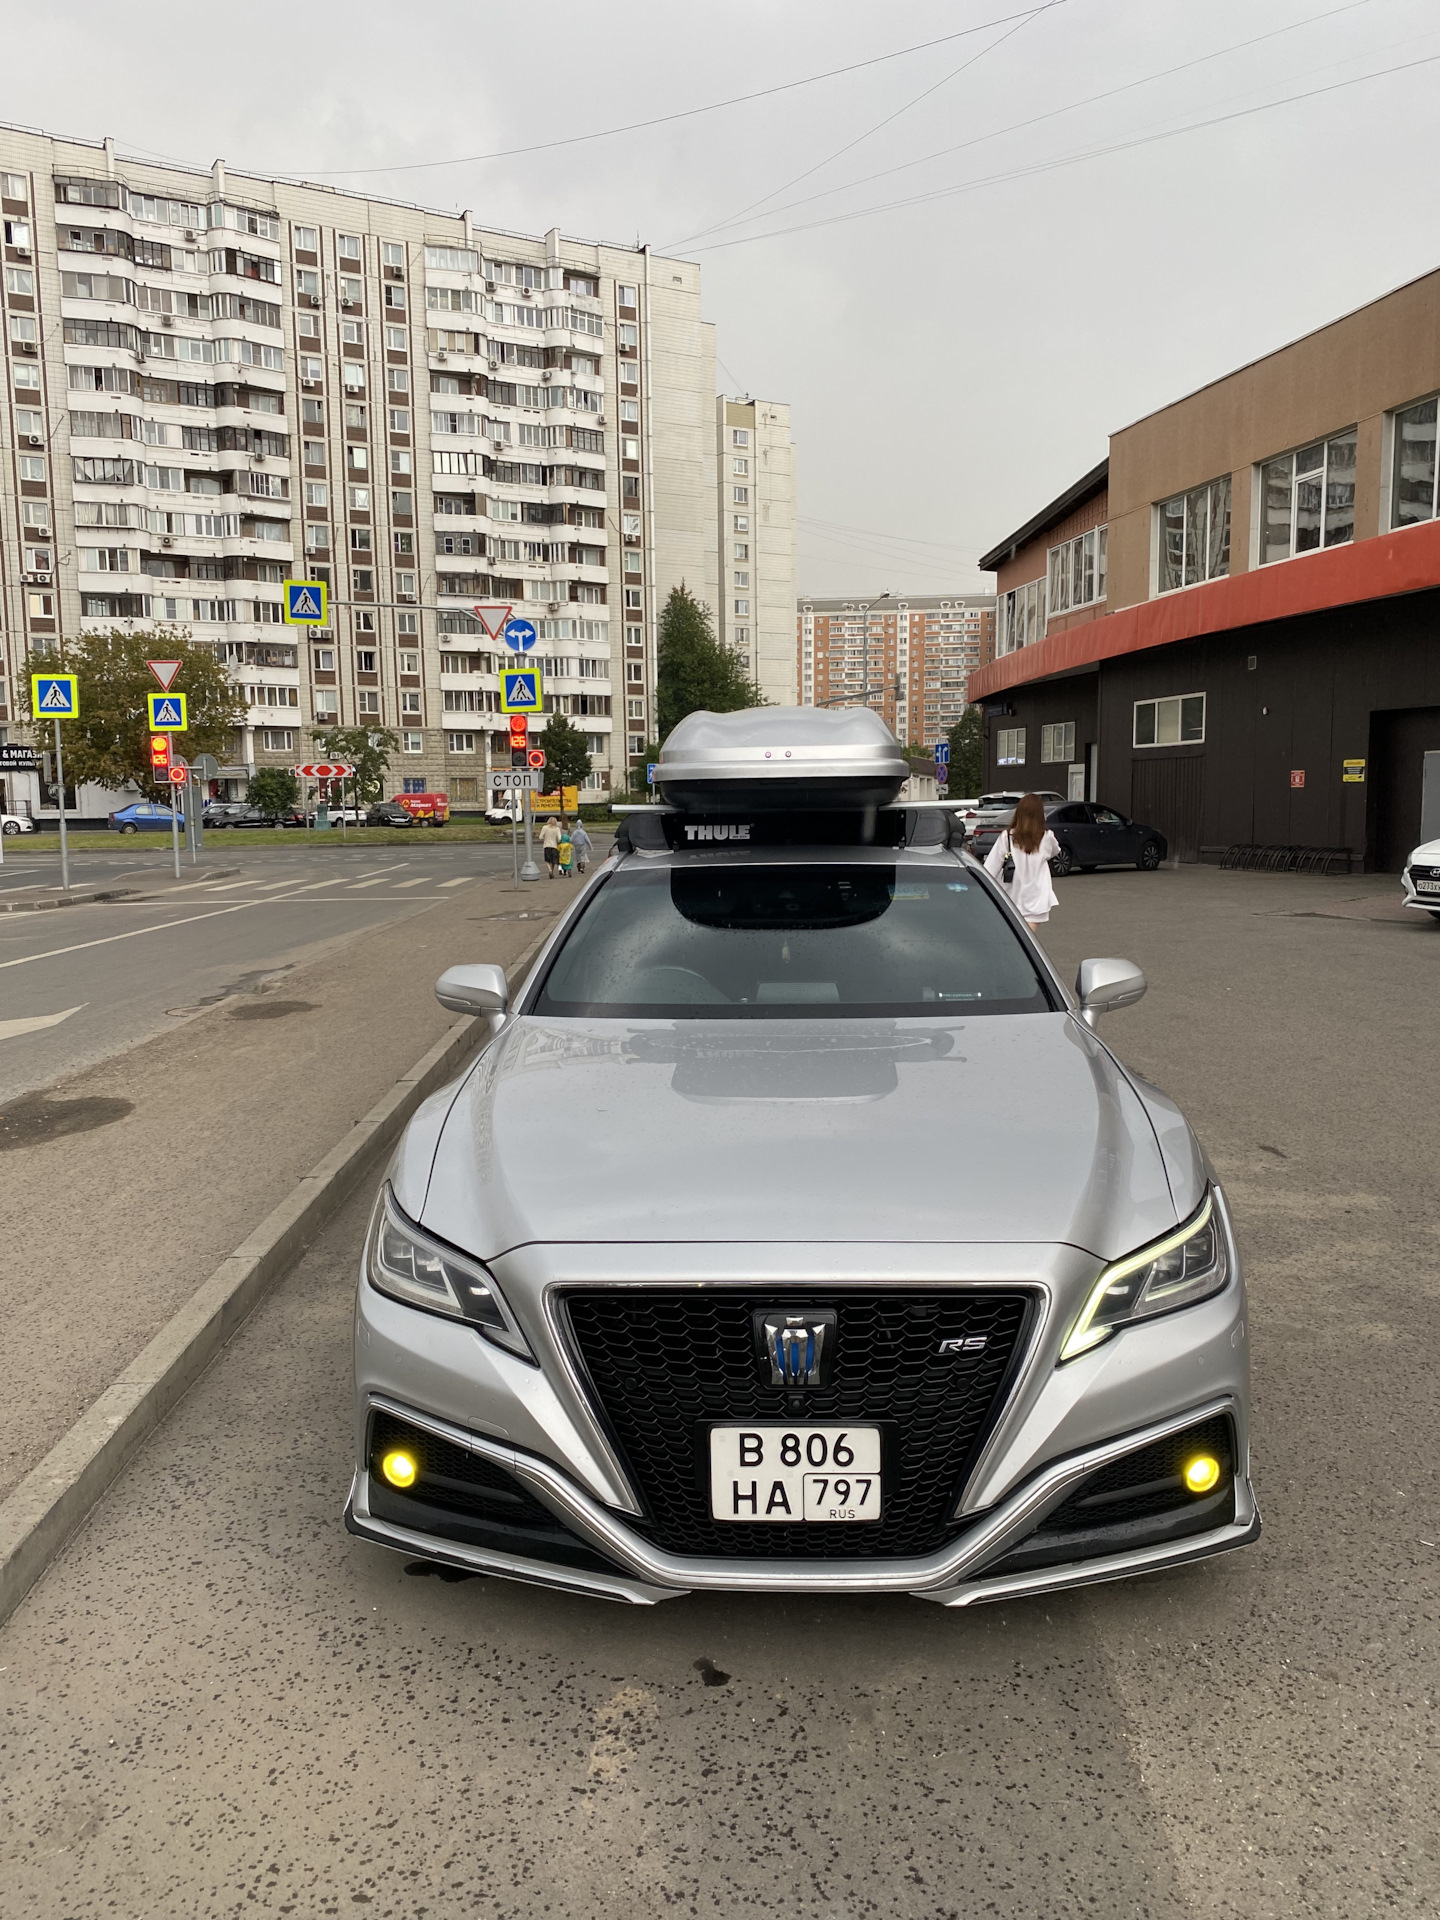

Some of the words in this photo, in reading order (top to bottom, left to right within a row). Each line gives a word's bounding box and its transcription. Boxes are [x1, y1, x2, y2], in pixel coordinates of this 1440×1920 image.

[511, 736, 525, 747] 126
[2, 750, 9, 759] &
[153, 754, 167, 765] 126
[493, 775, 531, 787] СТОП
[684, 825, 750, 840] THULE
[938, 1337, 987, 1353] RS
[780, 1433, 854, 1467] 806
[812, 1479, 872, 1506] 797
[829, 1509, 855, 1519] RUS
